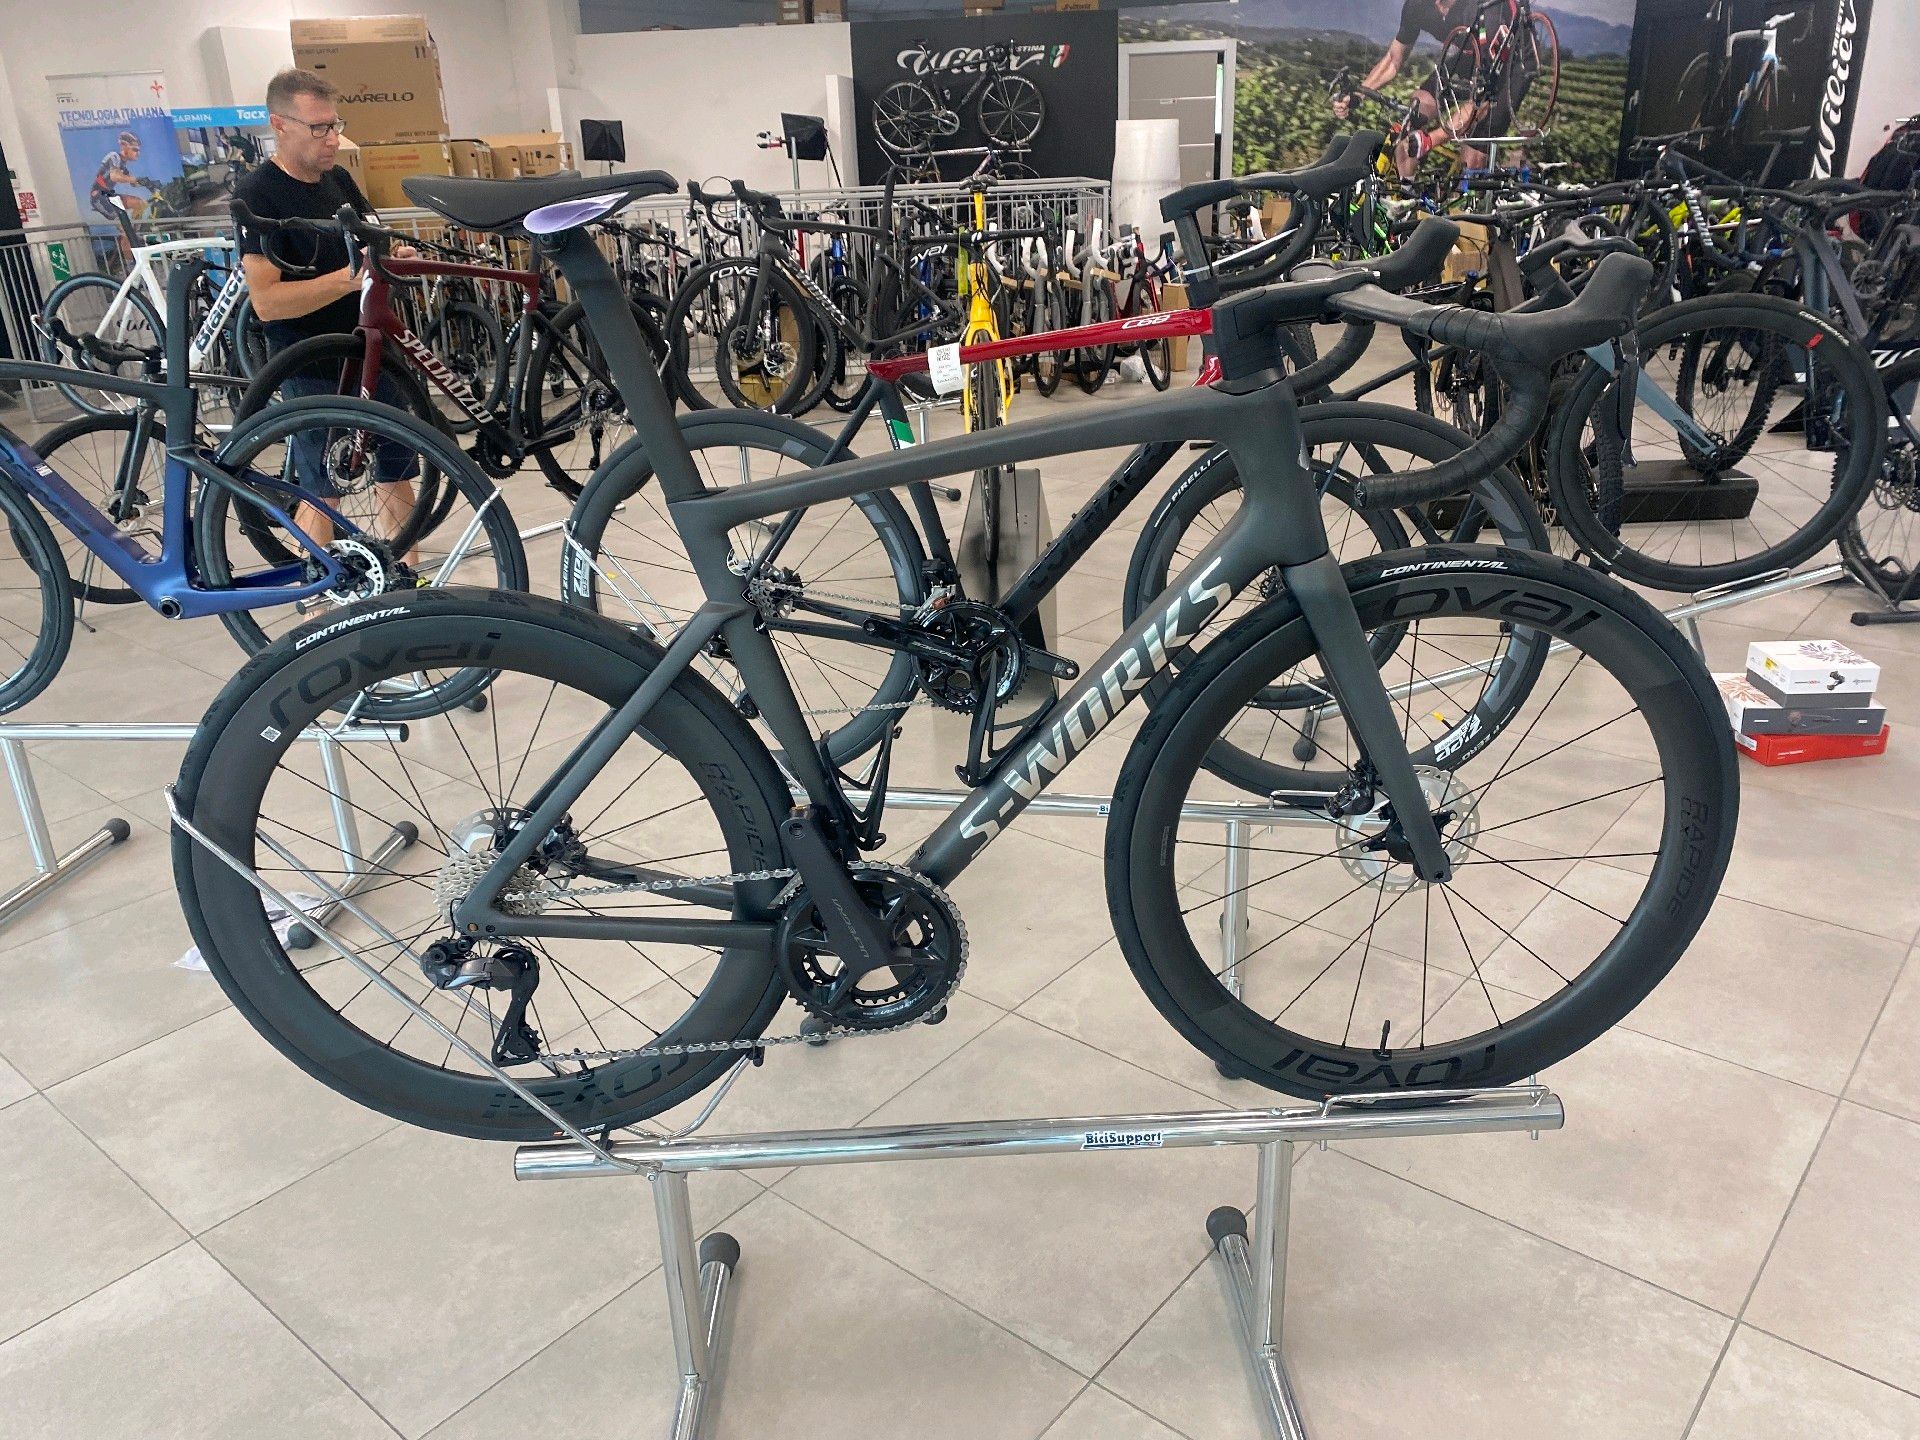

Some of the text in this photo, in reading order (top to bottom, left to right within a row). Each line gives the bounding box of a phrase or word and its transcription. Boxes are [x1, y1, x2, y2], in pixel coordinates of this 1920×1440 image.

[337, 91, 414, 104] NARELLO
[59, 106, 168, 122] TECNOLOGIA ITALIANA
[236, 109, 266, 120] Tacx
[909, 244, 947, 269] oval
[709, 264, 760, 283] rova
[195, 261, 246, 352] Bianch
[1121, 314, 1170, 330] C68
[394, 329, 494, 424] SPECIALIZED
[1171, 459, 1211, 502] PIRELLI
[1380, 559, 1509, 579] CONTINENTAL
[1383, 586, 1602, 635] oval
[295, 606, 411, 651] CONTINENTAL
[960, 556, 1232, 859] S-WORKS
[1085, 1131, 1162, 1144] BiciSupport
